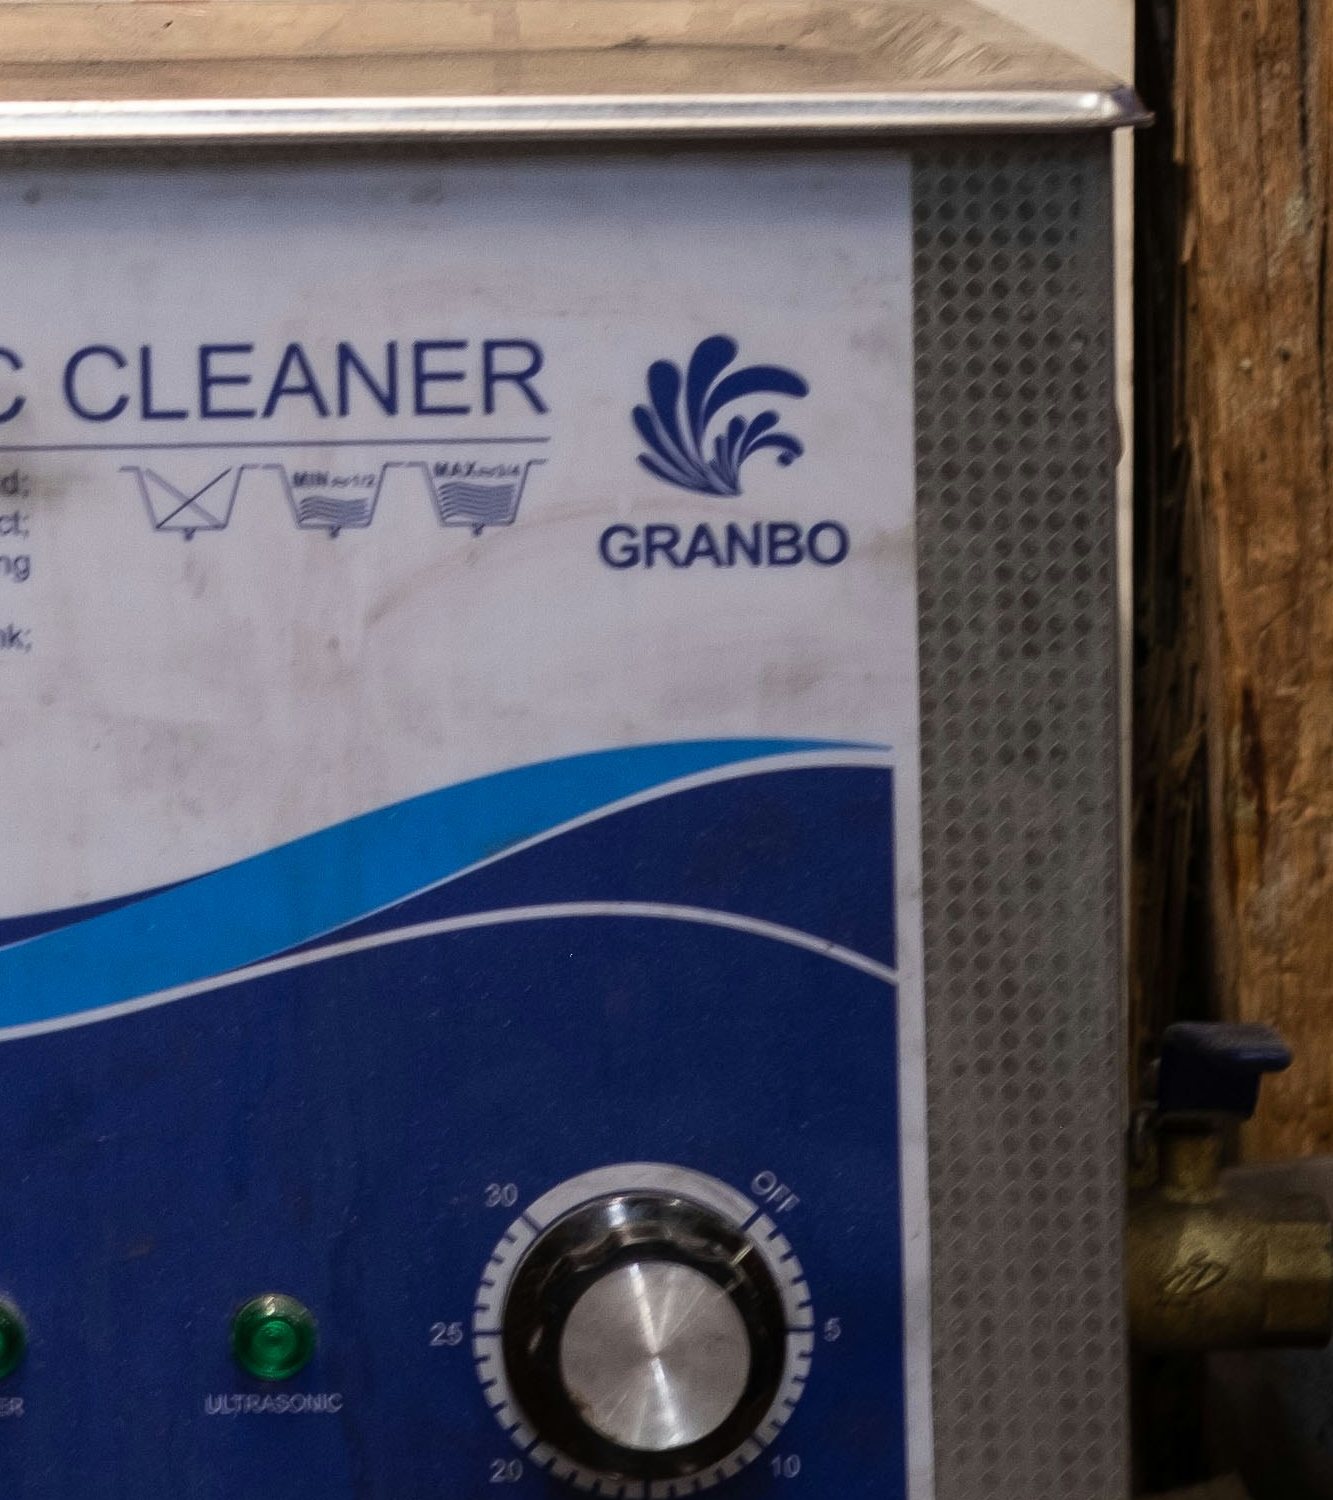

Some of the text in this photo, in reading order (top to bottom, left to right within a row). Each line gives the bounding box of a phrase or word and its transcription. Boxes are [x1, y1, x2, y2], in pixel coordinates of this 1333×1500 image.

[61, 337, 550, 423] CLEANER
[598, 517, 852, 571] GRANBO
[484, 1182, 520, 1208] 30
[750, 1170, 800, 1214] OFF
[429, 1321, 464, 1347] 25
[823, 1317, 843, 1342] 5
[202, 1392, 345, 1418] ULTRASONIC
[489, 1457, 524, 1484] 20
[772, 1454, 802, 1479] 10
